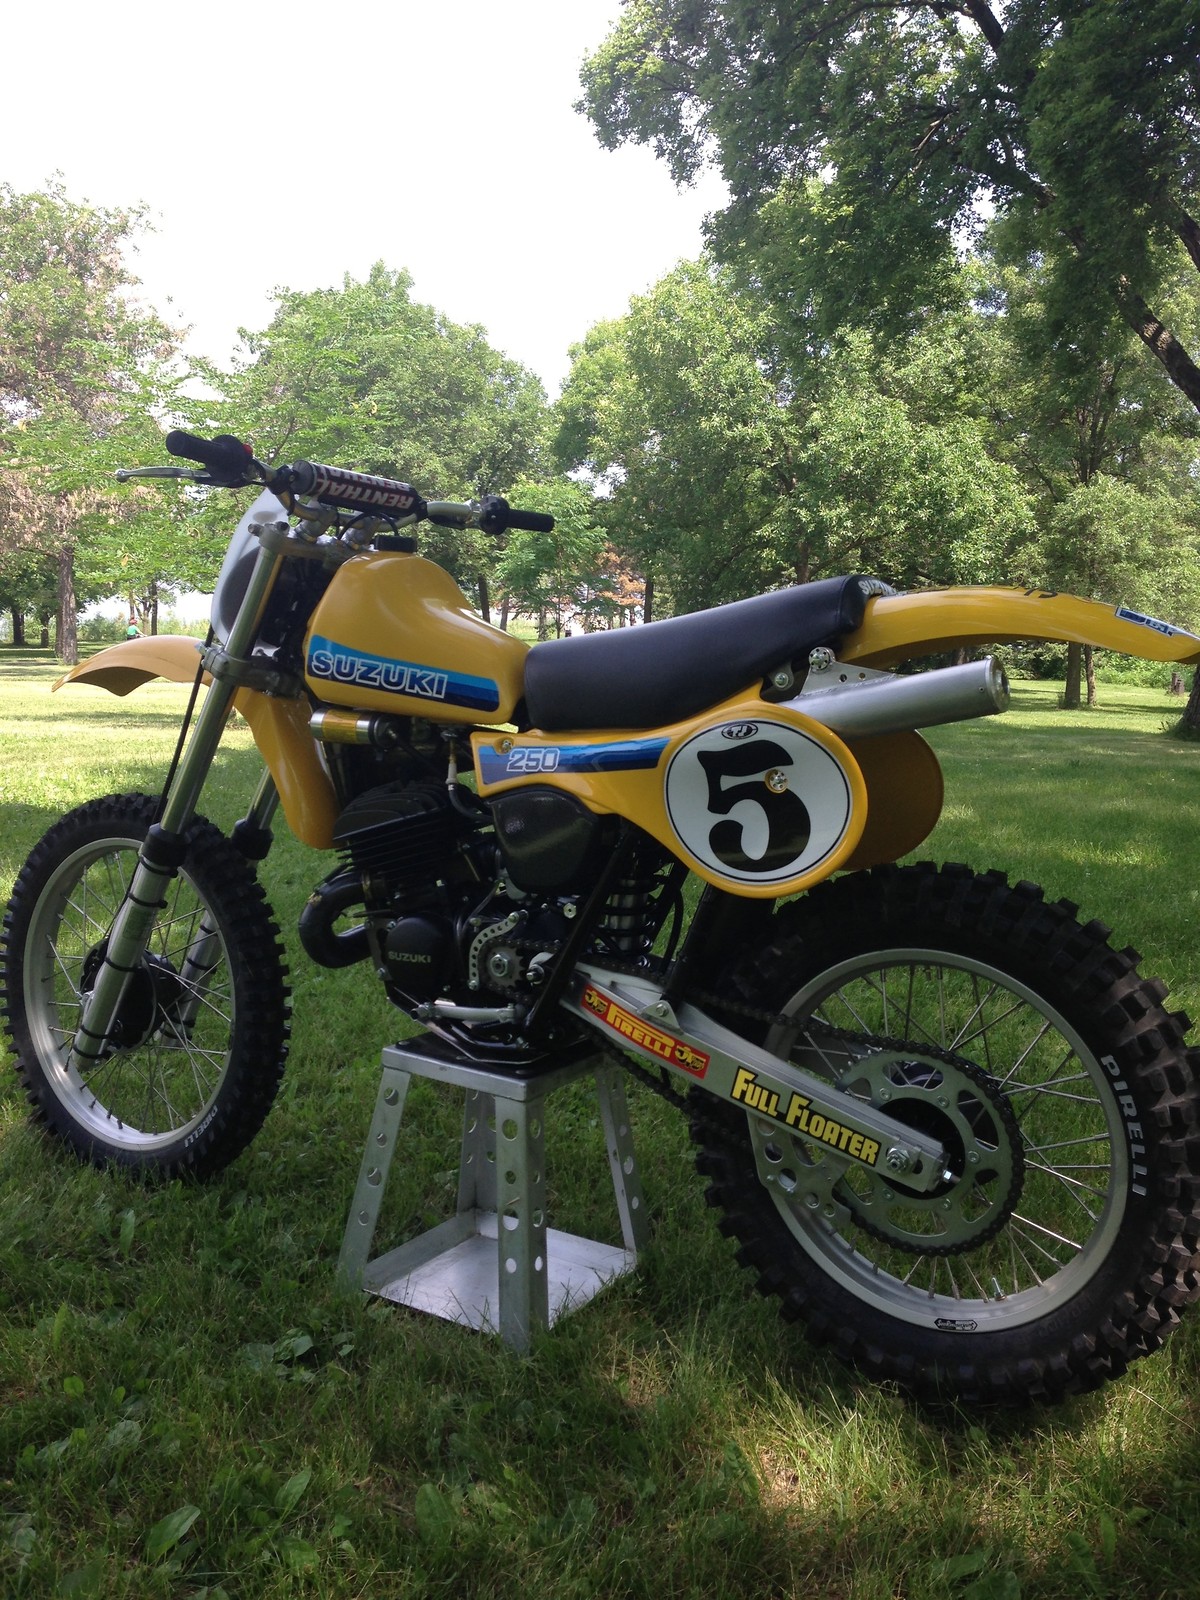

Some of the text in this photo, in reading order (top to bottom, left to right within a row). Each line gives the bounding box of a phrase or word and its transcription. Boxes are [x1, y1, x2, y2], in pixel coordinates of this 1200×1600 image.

[316, 478, 414, 510] RENTHAL
[311, 650, 448, 699] SUZUKI
[506, 747, 561, 772] 250
[697, 740, 809, 872] 5
[388, 950, 432, 963] SUZUKI
[606, 1002, 675, 1058] PIRELLI
[184, 1104, 218, 1148] PIRELLI
[731, 1067, 881, 1166] FULL FLOATER
[1101, 1054, 1148, 1197] PIRELLI
